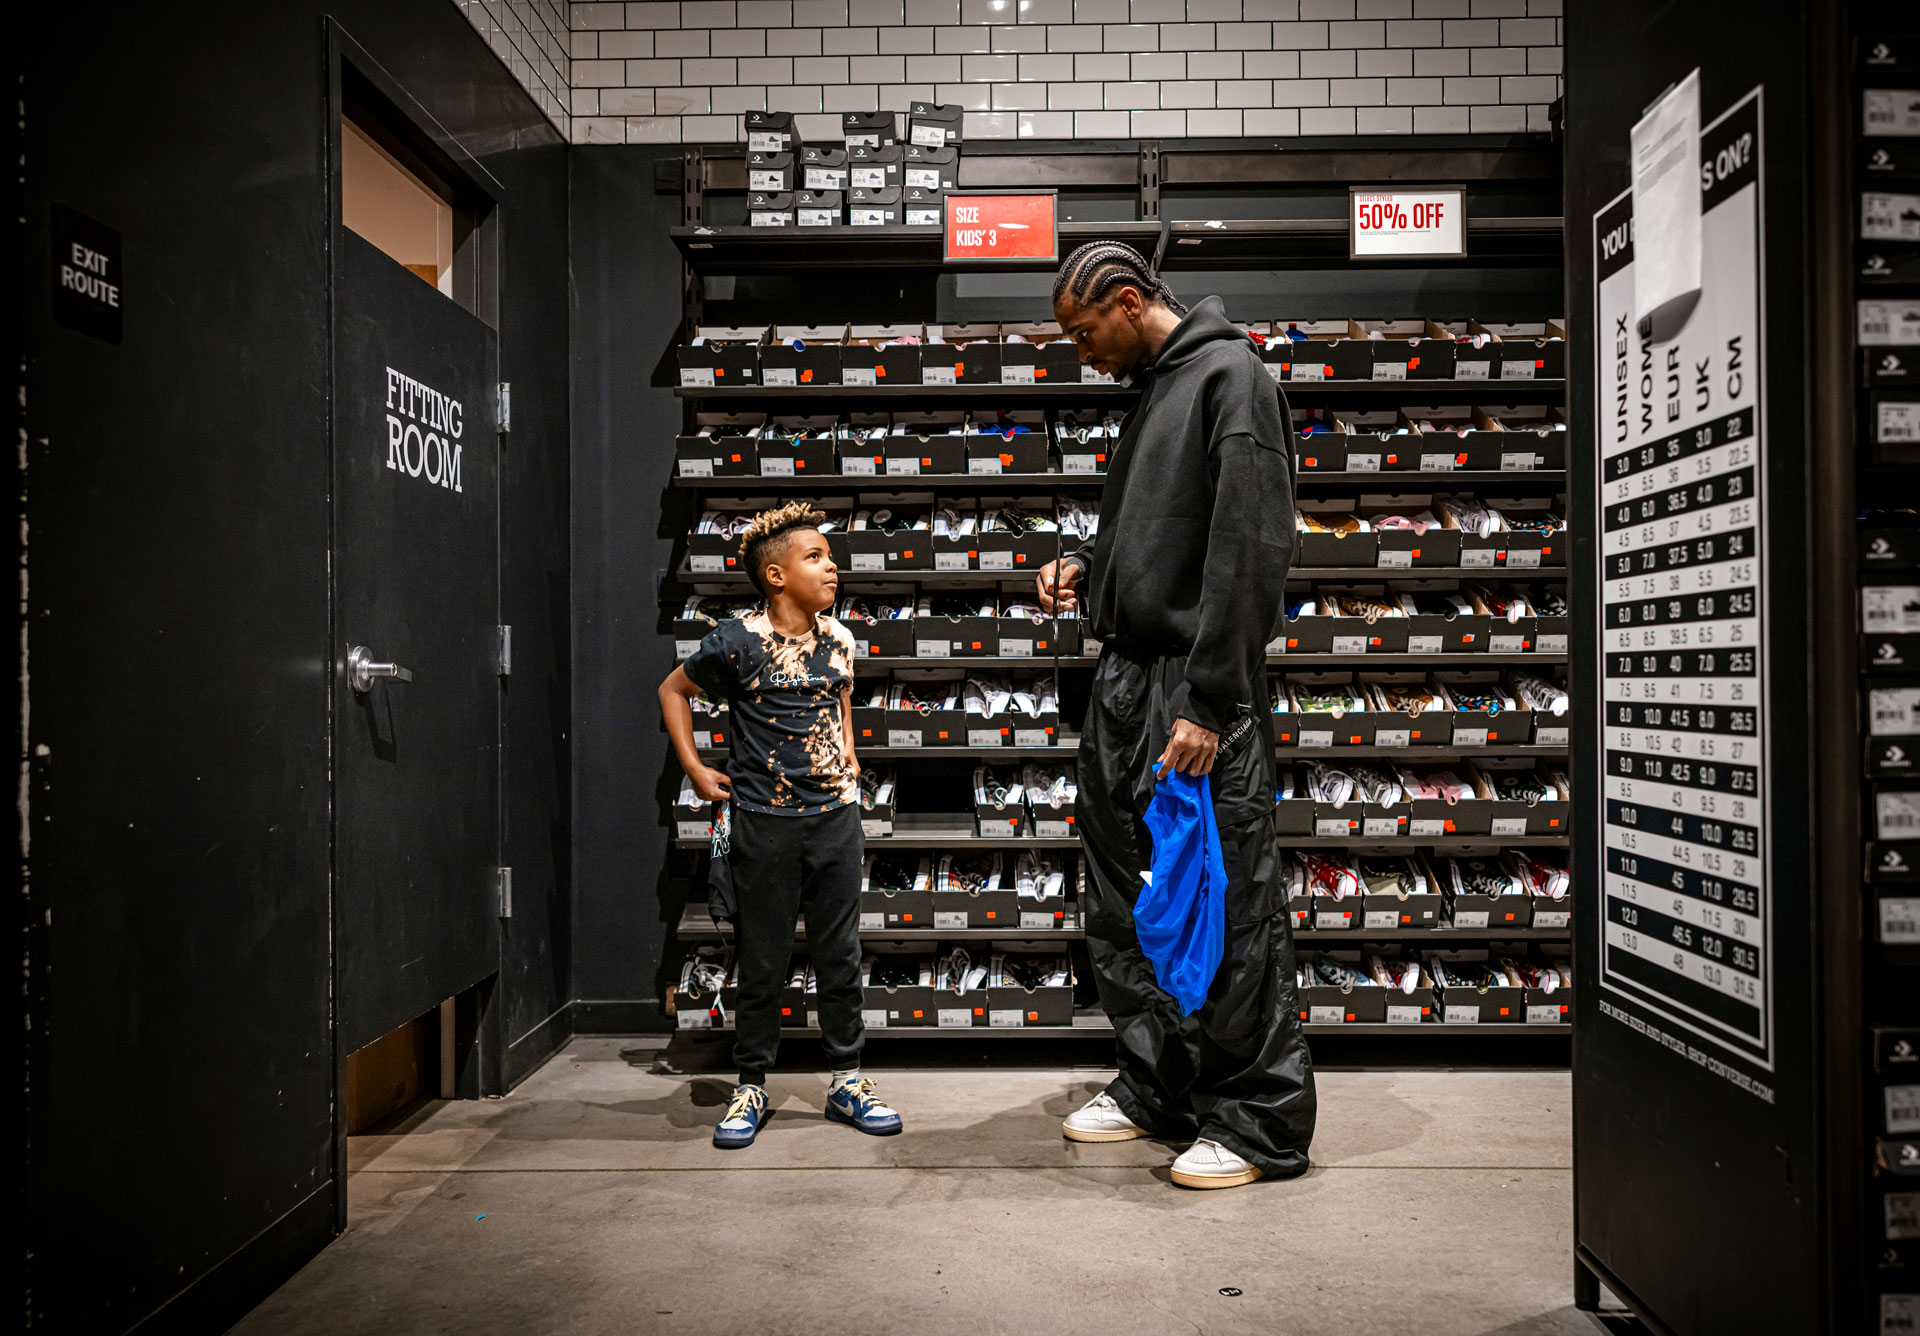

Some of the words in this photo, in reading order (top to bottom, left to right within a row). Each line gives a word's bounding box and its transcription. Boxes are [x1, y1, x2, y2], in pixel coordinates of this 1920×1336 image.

[1716, 132, 1752, 181] ON?
[956, 207, 979, 224] SIZE
[1359, 203, 1407, 230] 50%
[1413, 203, 1444, 229] OFF
[988, 229, 997, 247] 3
[1601, 222, 1628, 260] YOU
[72, 242, 109, 277] EXIT
[61, 264, 119, 308] ROUTE
[1616, 312, 1628, 443] UNISEX
[1641, 316, 1653, 436] WOME
[1667, 345, 1680, 423] EUR
[1696, 356, 1710, 413] UK
[1727, 335, 1743, 400] CM
[386, 366, 463, 439] FITTING
[386, 414, 463, 493] ROOM
[1617, 457, 1630, 475] 3.0
[1641, 448, 1654, 466] 5.0
[1667, 439, 1680, 457] 35
[1696, 428, 1712, 448] 3.0
[1727, 417, 1742, 438] 22
[1618, 483, 1629, 498] 3.5
[1642, 474, 1654, 491] 5.5
[1697, 457, 1711, 475] 3.5
[1618, 507, 1630, 523] 4.0
[1642, 500, 1655, 517] 6.0
[1668, 491, 1687, 511] 36.5
[1697, 485, 1713, 503] 4.0
[1728, 476, 1742, 496] 23
[1619, 533, 1630, 547] 4.5
[1643, 527, 1654, 543] 6.5
[1669, 521, 1679, 537] 37
[1698, 514, 1712, 531] 4.5
[1618, 558, 1630, 573] 5.0
[1643, 552, 1655, 569] 7.0
[1668, 546, 1688, 565] 37.5
[1698, 541, 1713, 560] 5.0
[1729, 535, 1743, 555] 24
[1619, 584, 1630, 597] 5.5
[1643, 579, 1655, 594] 7.5
[1669, 575, 1680, 591] 38
[1699, 570, 1712, 587] 5.5
[1730, 564, 1751, 583] 24.5
[1619, 608, 1631, 623] 6.0
[1643, 604, 1656, 621] 8.0
[1669, 601, 1681, 618] 39
[1698, 597, 1714, 615] 6.0
[1729, 593, 1752, 613] 24.5
[1620, 633, 1630, 647] 6.5
[1644, 631, 1655, 646] 8.5
[1700, 627, 1713, 643] 6.5
[1730, 625, 1742, 642] 25
[1619, 658, 1631, 672] 7.0
[1643, 657, 1656, 672] 9.0
[1669, 656, 1682, 672] 40
[1699, 654, 1714, 672] 7.0
[1730, 653, 1752, 672] 25.5
[1620, 683, 1631, 697] 7.5
[1644, 683, 1656, 698] 9.5
[1671, 684, 1680, 698] 41
[1700, 684, 1713, 699] 7.5
[1620, 708, 1632, 722] 8.0
[1645, 708, 1661, 725] 10.0
[1670, 710, 1689, 727] 41.5
[1699, 711, 1715, 728] 8.0
[1621, 733, 1631, 747] 8.5
[1645, 736, 1661, 750] 10.5
[1671, 738, 1681, 752] 42
[1701, 740, 1714, 756] 8.5
[1732, 742, 1744, 759] 27
[1620, 757, 1632, 772] 9.0
[1645, 761, 1662, 777] 11.0
[1671, 764, 1690, 781] 42.5
[1700, 767, 1716, 785] 9.0
[1731, 771, 1754, 791] 27.5
[1621, 783, 1631, 797] 9.5
[1701, 796, 1715, 813] 9.5
[1621, 807, 1636, 824] 10.0
[1672, 817, 1683, 834] 44
[1702, 824, 1722, 843] 10.0
[1622, 833, 1636, 848] 10.5
[1672, 845, 1690, 863] 44.5
[1703, 853, 1721, 871] 10.5
[1621, 857, 1637, 875] 11.0
[1672, 871, 1684, 889] 45
[1702, 880, 1722, 900] 11.0
[1622, 883, 1636, 899] 11.5
[1703, 909, 1721, 928] 11.5
[1734, 918, 1746, 936] 30
[1621, 907, 1638, 925] 12.0
[1673, 925, 1692, 946] 46.5
[1702, 936, 1723, 958] 12.0
[1733, 947, 1755, 971] 30.5
[1623, 933, 1637, 950] 13.0
[1703, 964, 1722, 986] 13.0
[1734, 977, 1755, 1000] 31.5
